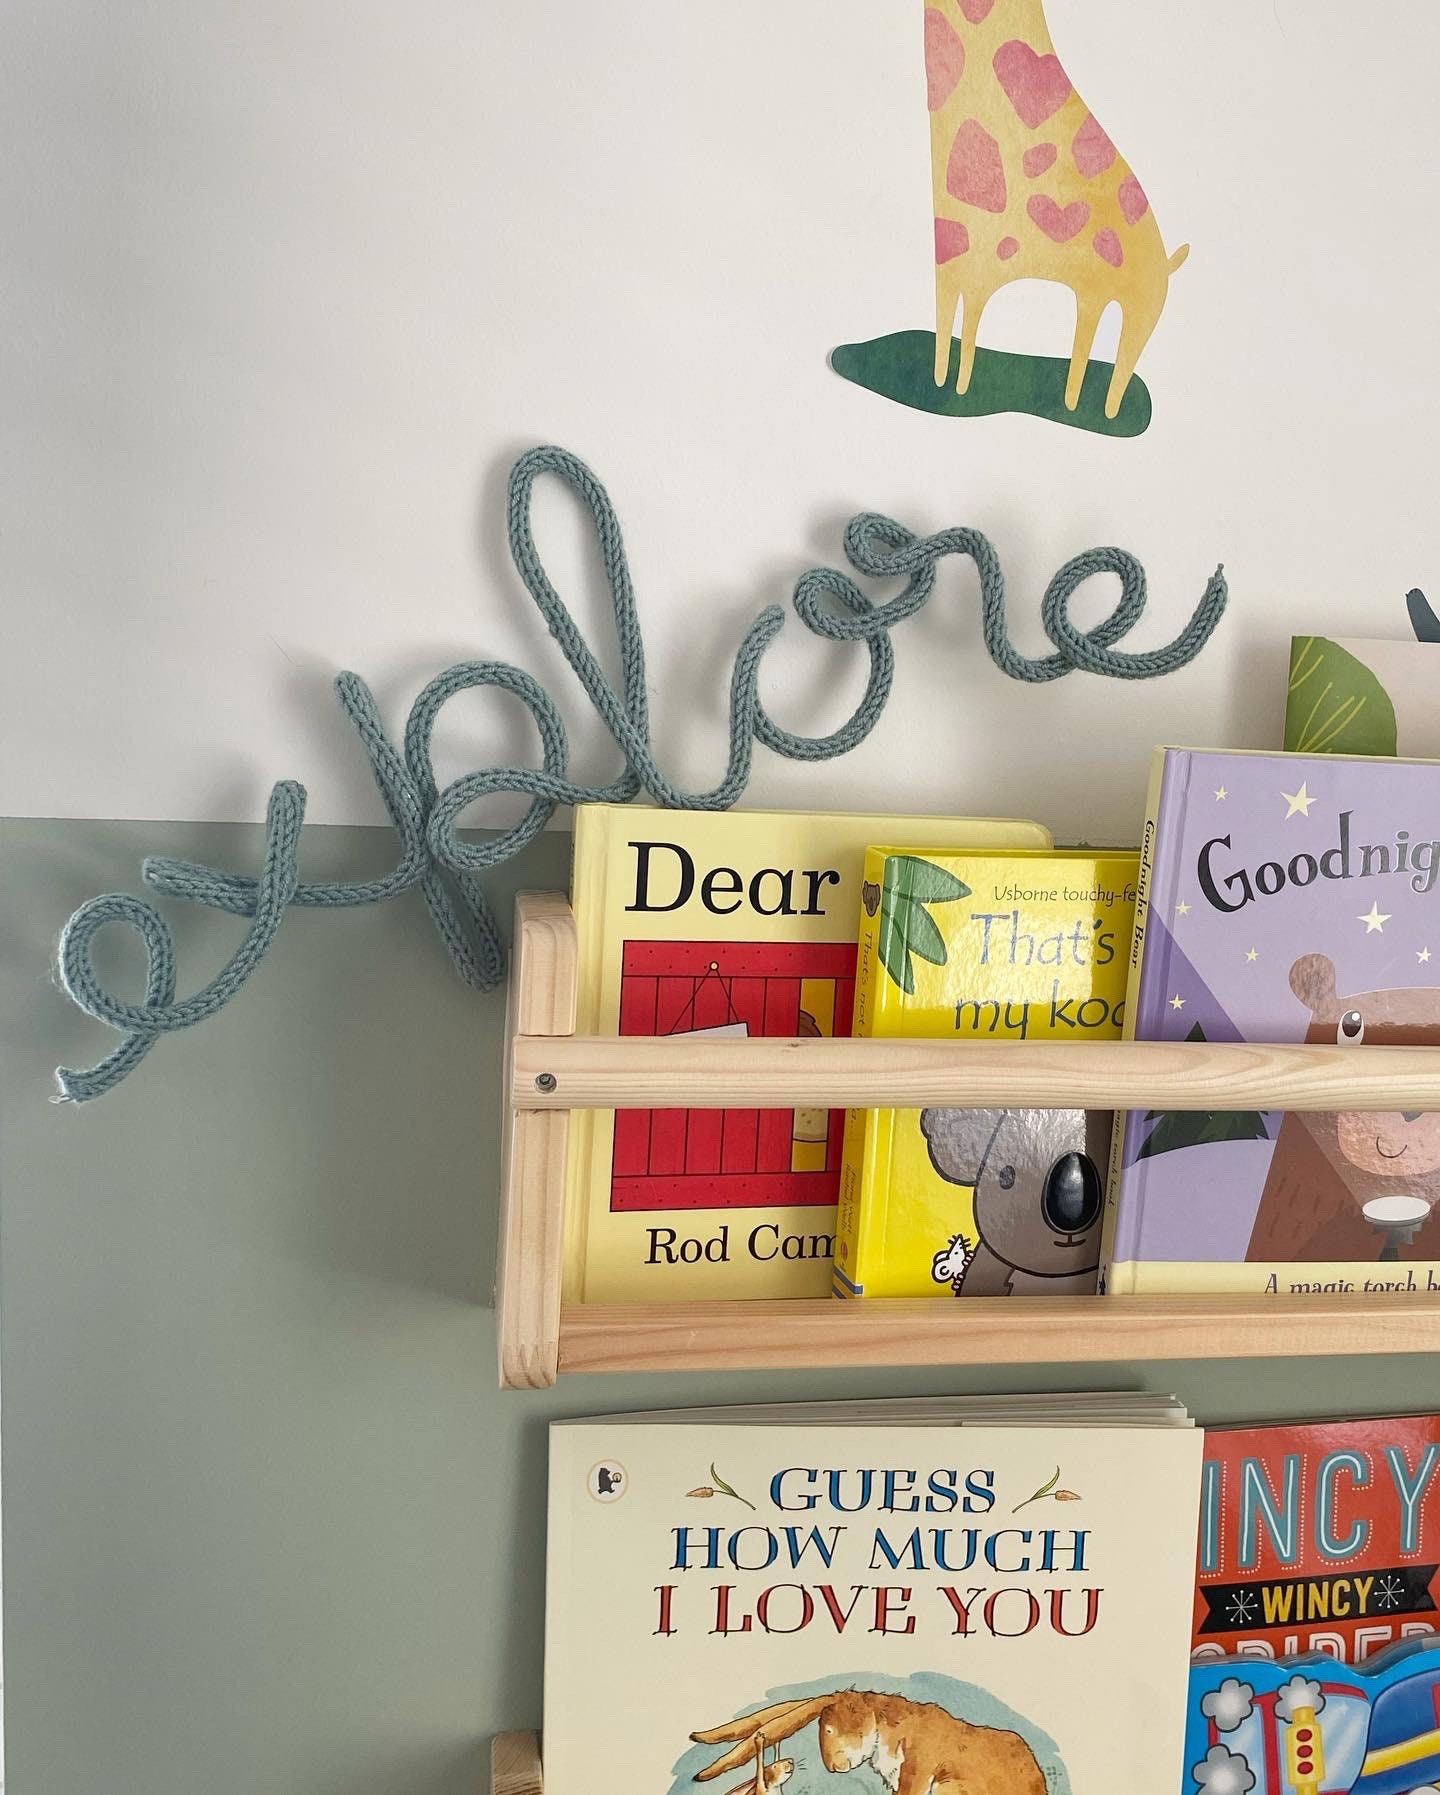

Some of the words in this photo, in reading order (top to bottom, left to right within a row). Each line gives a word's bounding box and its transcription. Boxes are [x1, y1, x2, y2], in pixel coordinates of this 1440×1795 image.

[625, 841, 840, 916] Dear
[1136, 820, 1155, 917] Goodnight
[1197, 810, 1440, 913] Goodnig
[994, 883, 1058, 902] Usborne
[862, 931, 873, 986] That's
[970, 910, 1115, 965] That's
[1131, 925, 1145, 969] Bear
[858, 993, 866, 1025] not
[955, 998, 1030, 1040] my
[644, 1226, 730, 1264] Rod
[1264, 1273, 1278, 1294] A
[770, 1467, 996, 1514] GUESS
[1200, 1446, 1440, 1572] INCY
[669, 1526, 848, 1572] HOW
[868, 1527, 1092, 1574] MUCH
[652, 1584, 680, 1637] I
[709, 1583, 918, 1638] LOVE
[937, 1586, 1105, 1639] YOU
[1262, 1576, 1375, 1625] WINCY
